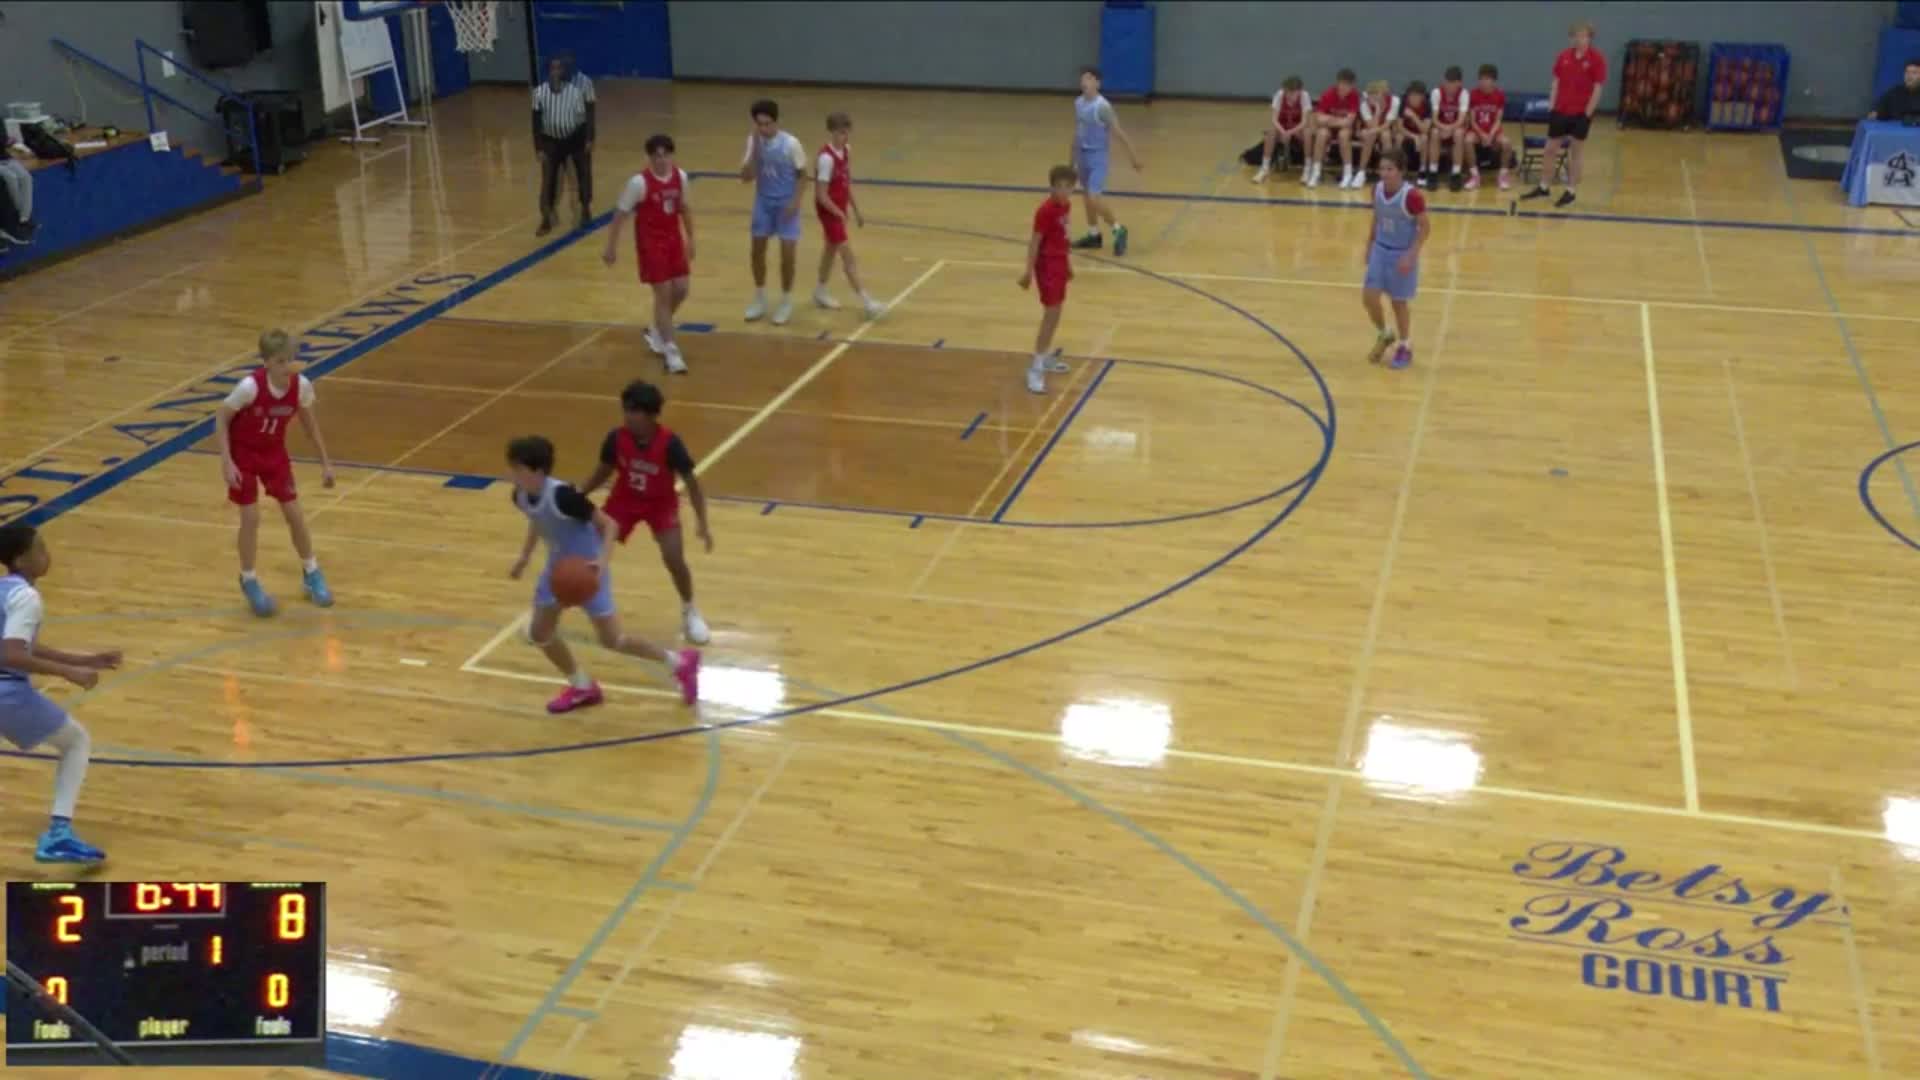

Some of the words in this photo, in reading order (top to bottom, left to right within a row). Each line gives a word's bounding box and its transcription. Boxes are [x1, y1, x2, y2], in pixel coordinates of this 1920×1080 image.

[260, 417, 278, 435] 11
[1512, 841, 1850, 929] Betsy
[1509, 893, 1794, 965] Ross
[1582, 953, 1787, 1011] COURT
